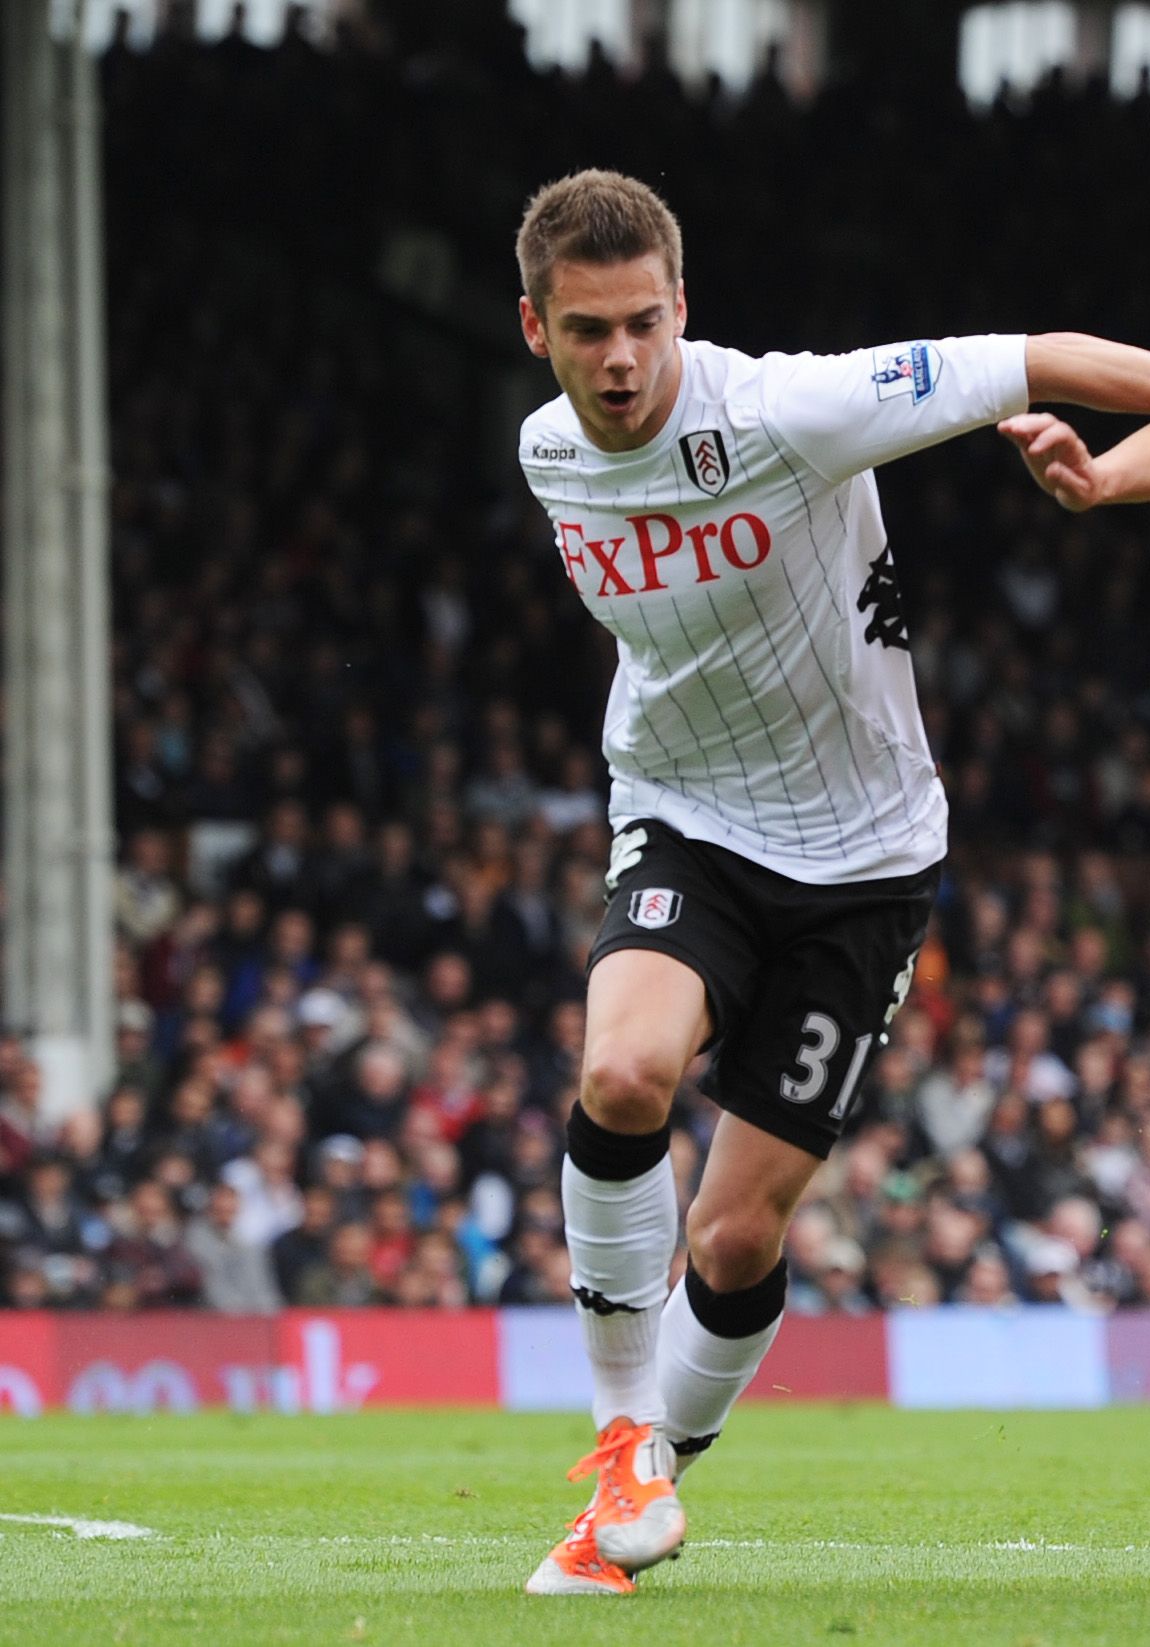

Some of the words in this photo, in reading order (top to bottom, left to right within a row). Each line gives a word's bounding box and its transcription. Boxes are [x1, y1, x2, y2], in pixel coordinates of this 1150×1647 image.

[532, 444, 576, 462] Kappa
[559, 512, 771, 597] FxPro
[780, 1012, 872, 1119] 31
